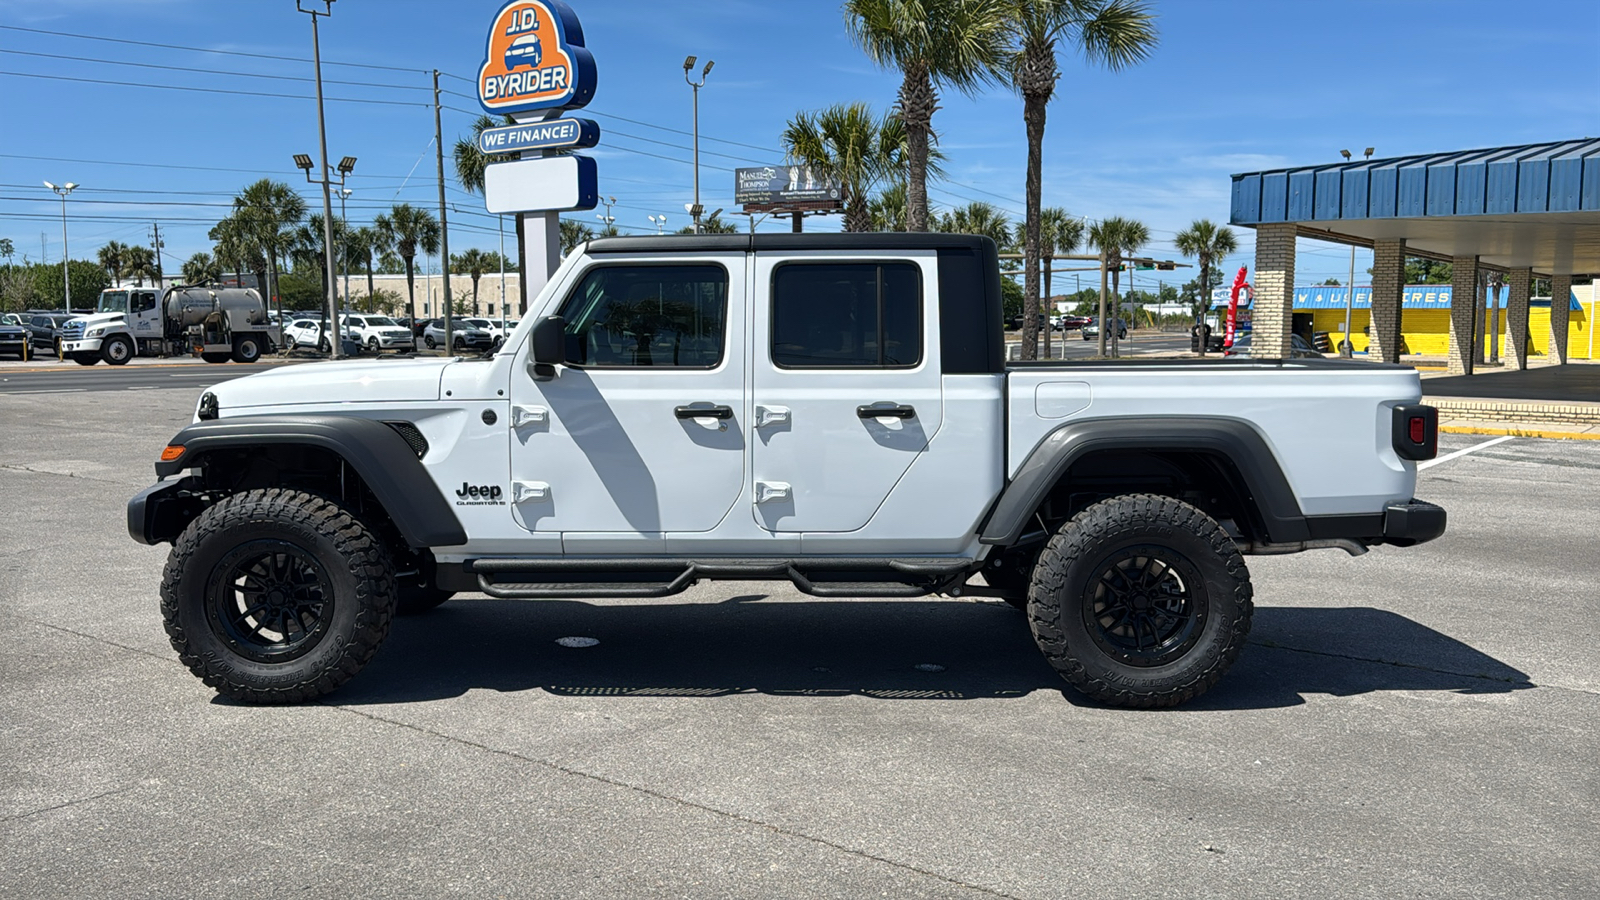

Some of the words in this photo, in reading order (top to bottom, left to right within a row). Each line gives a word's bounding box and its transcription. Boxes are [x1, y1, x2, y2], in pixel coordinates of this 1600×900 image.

[507, 8, 538, 34] J.D.
[484, 66, 566, 99] BYRIDER
[484, 133, 505, 147] WE
[507, 125, 575, 144] FINANCE!
[1402, 292, 1450, 303] IRES
[455, 482, 502, 500] Jeep
